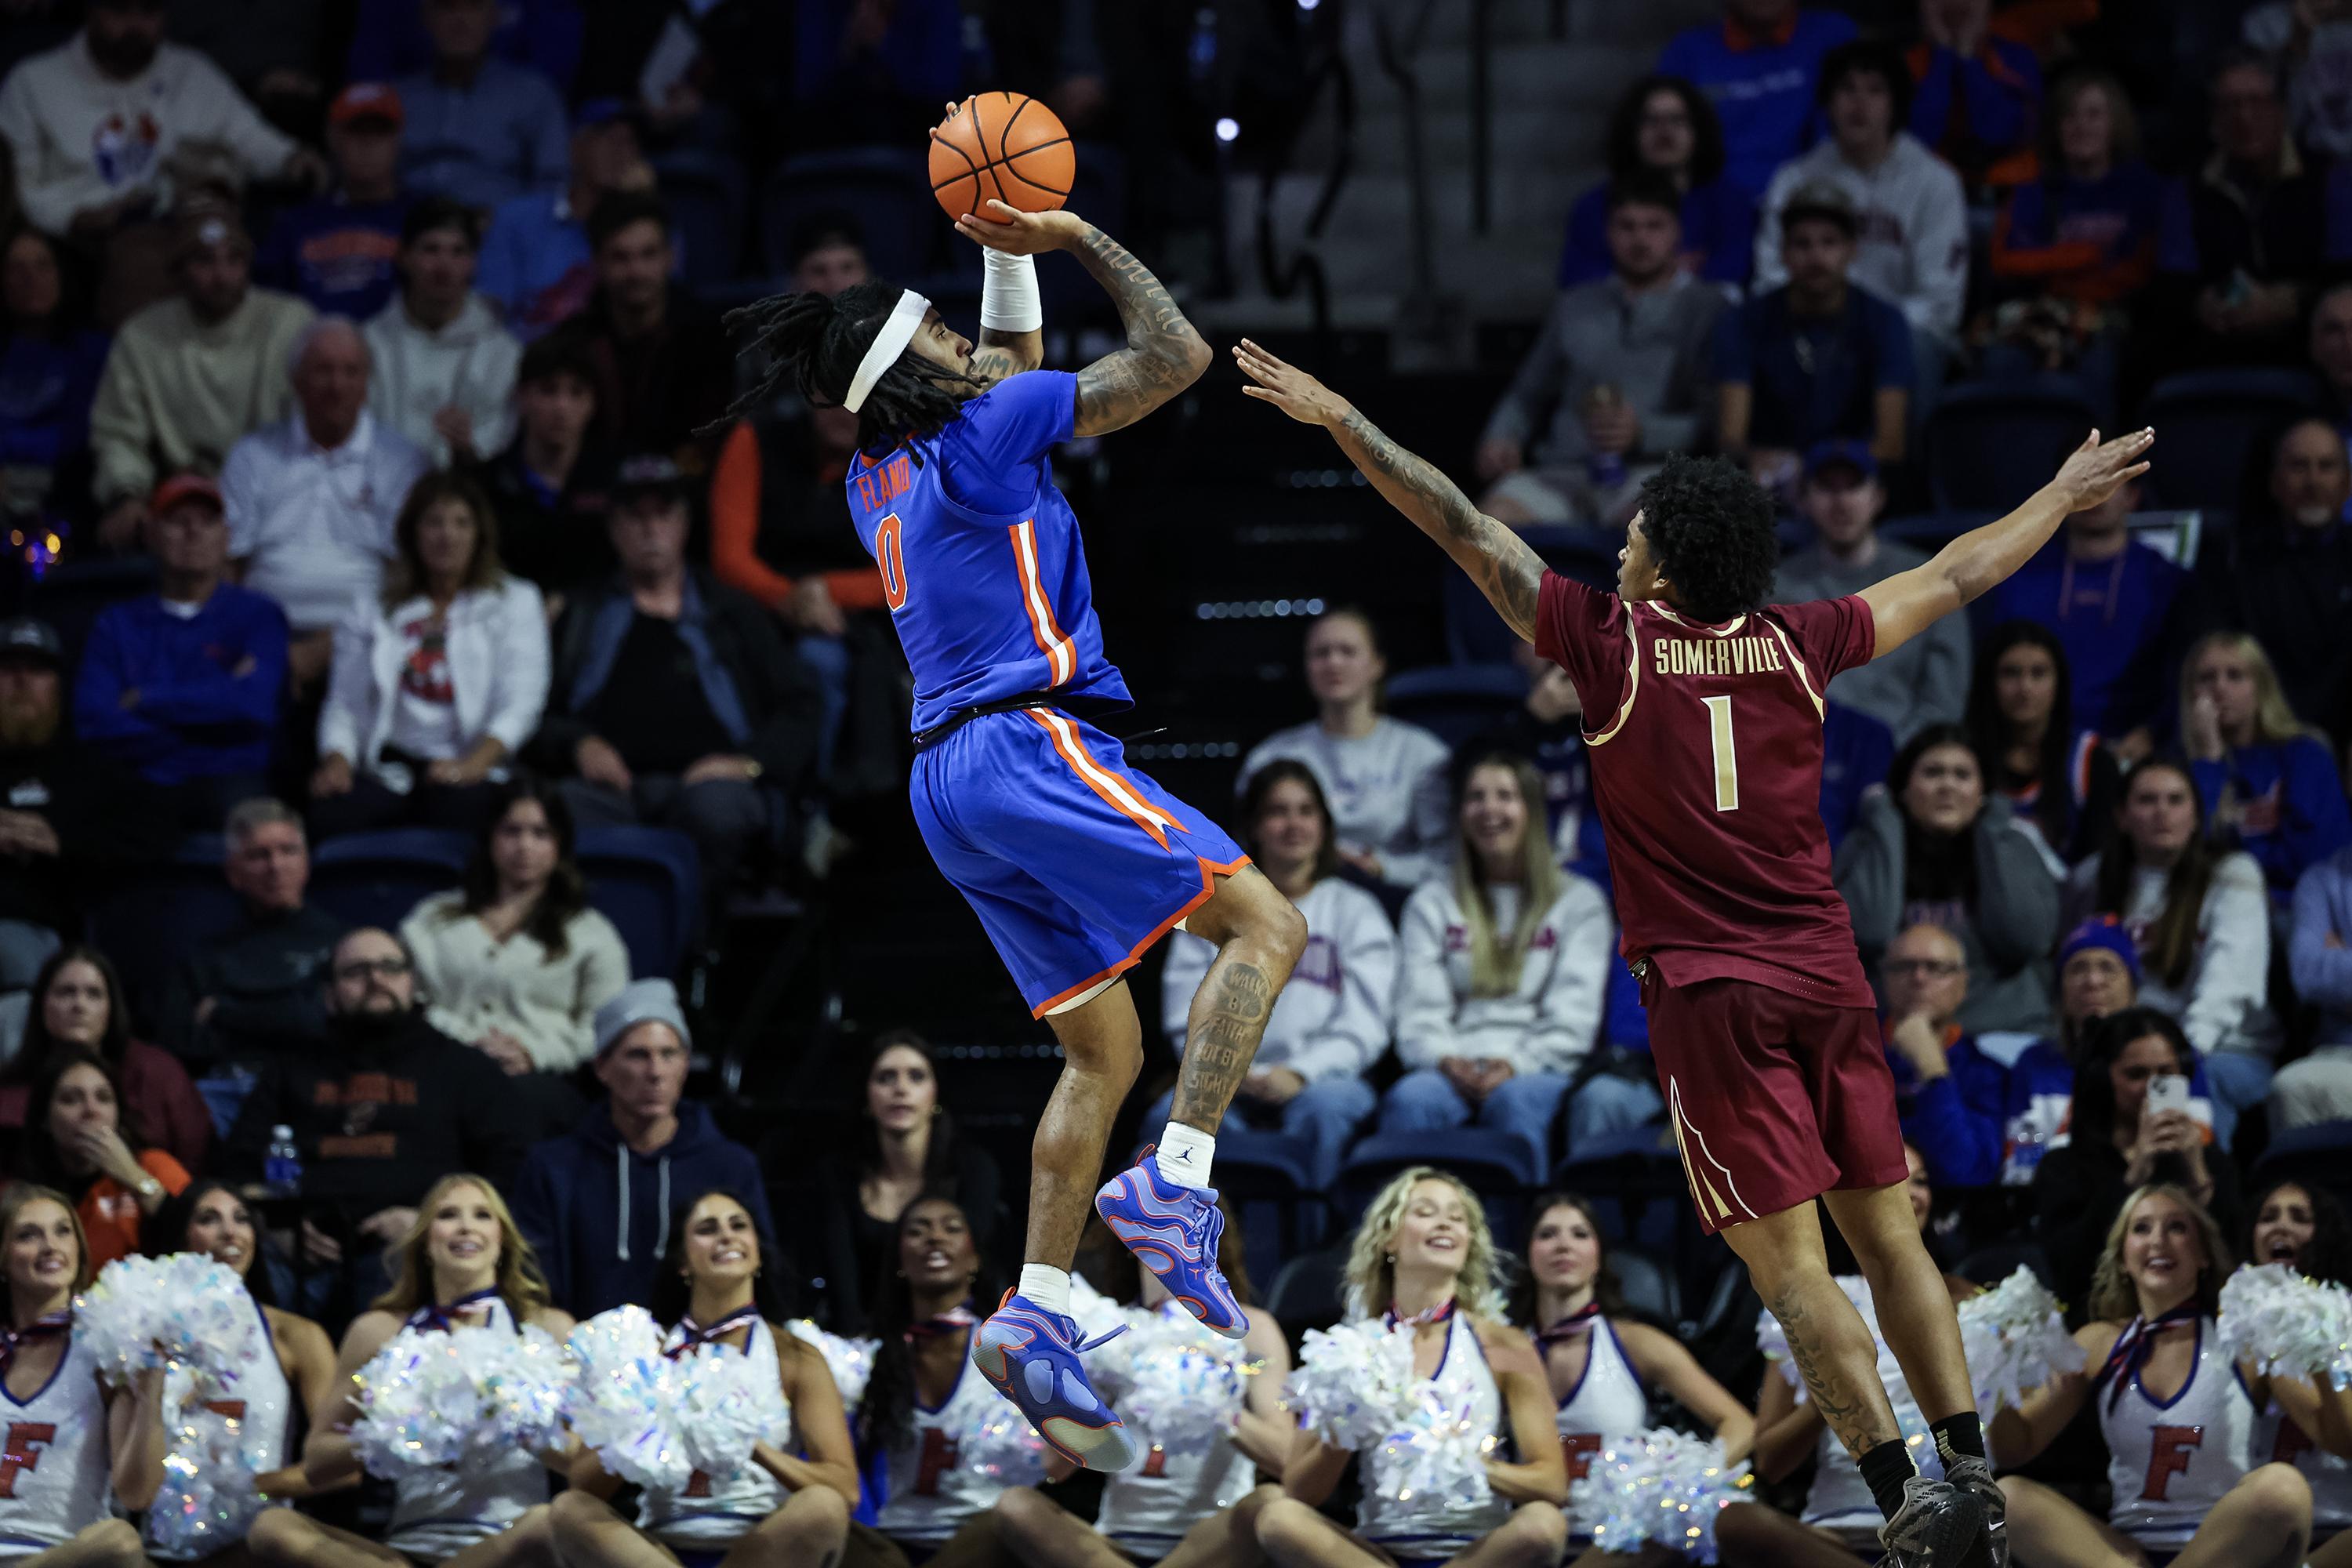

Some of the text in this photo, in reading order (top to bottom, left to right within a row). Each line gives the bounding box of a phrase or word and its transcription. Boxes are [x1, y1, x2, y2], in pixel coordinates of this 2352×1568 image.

[857, 456, 911, 513] FLAND
[875, 512, 908, 612] 0
[1654, 637, 1784, 675] SOMERVILLE
[1700, 695, 1739, 811] 1
[0, 1422, 56, 1499] F
[2138, 1425, 2204, 1501] F
